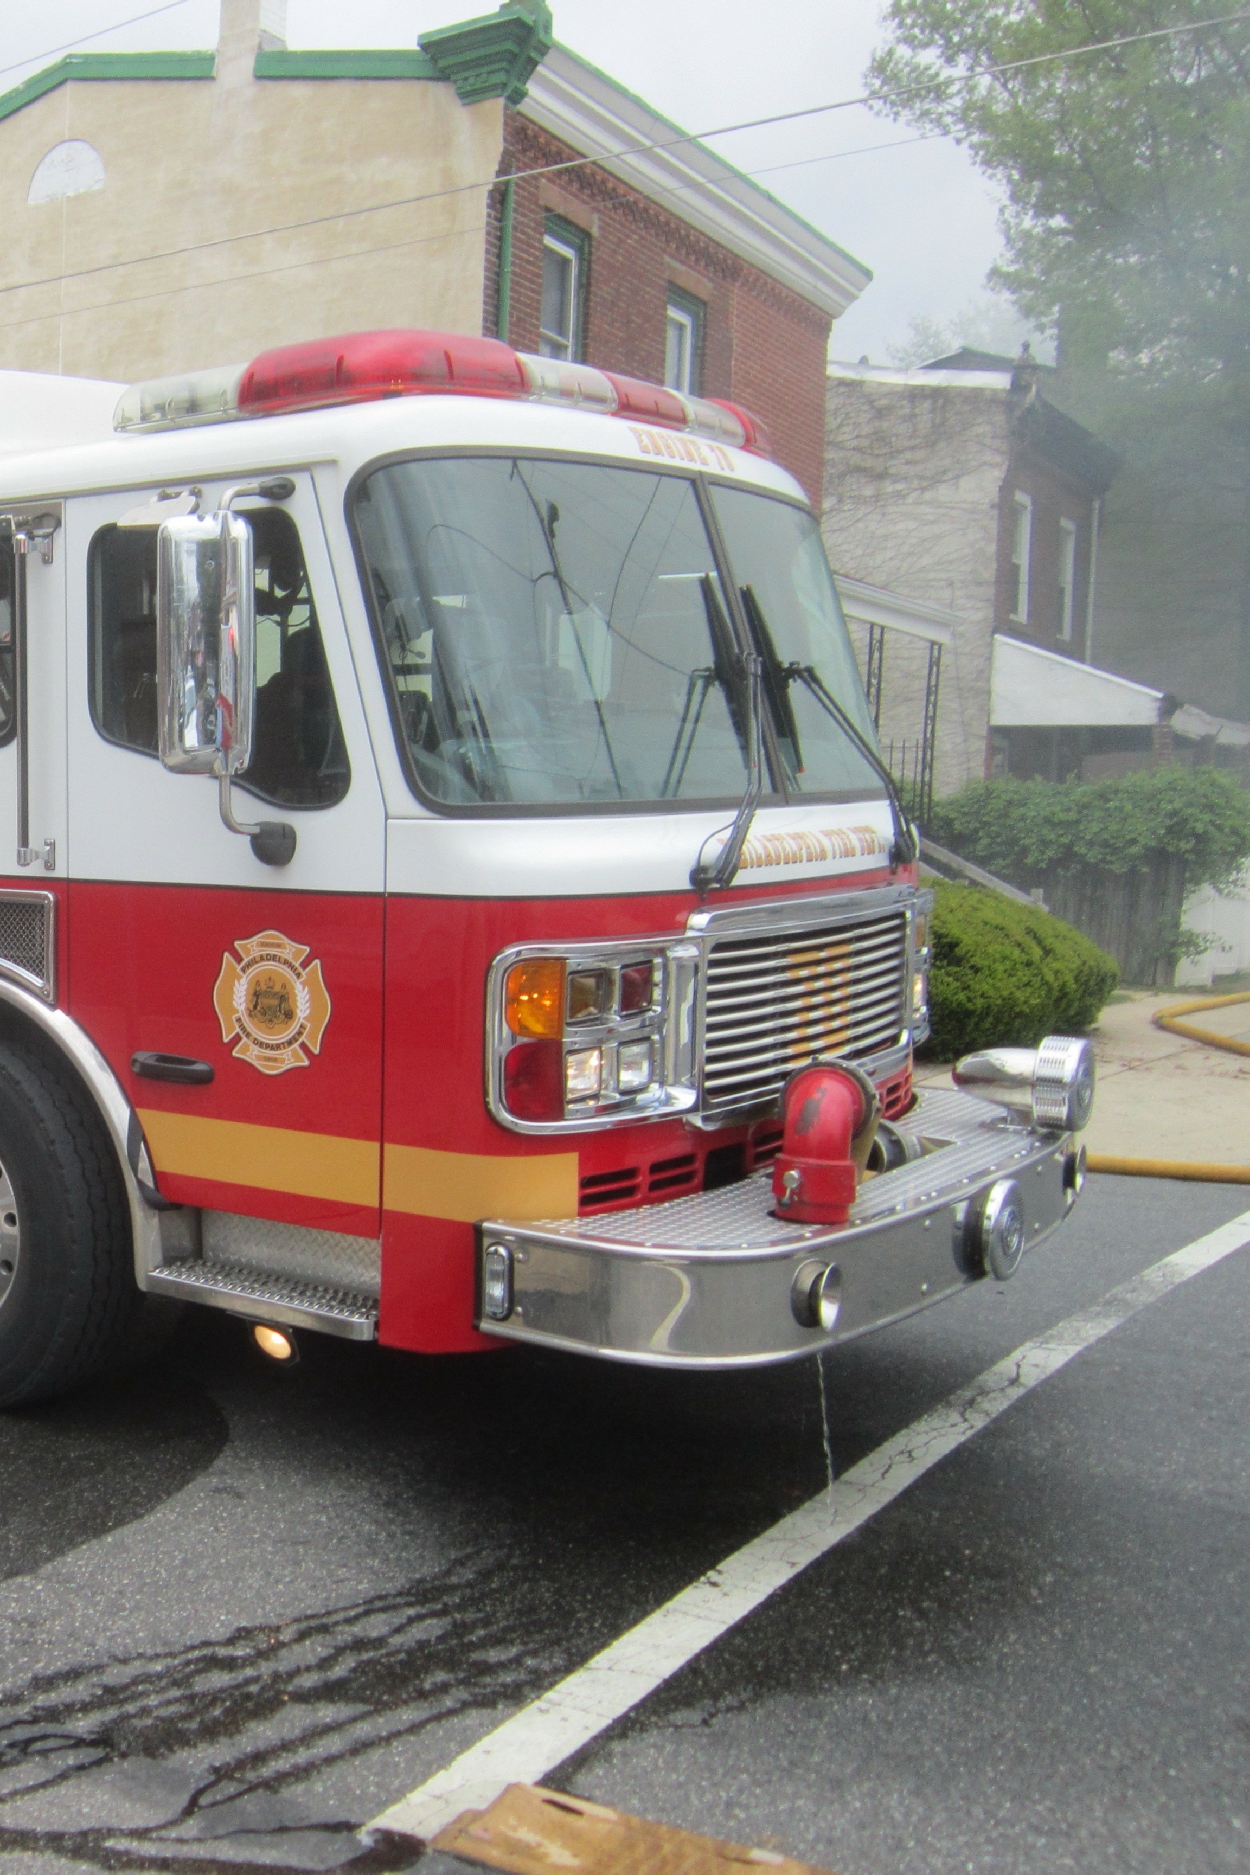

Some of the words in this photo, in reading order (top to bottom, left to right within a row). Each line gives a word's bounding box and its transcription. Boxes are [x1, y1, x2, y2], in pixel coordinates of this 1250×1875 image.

[240, 952, 302, 980] PHILADELPHIA
[235, 1017, 250, 1042] FIRE
[252, 1023, 306, 1051] DEPARTMENT
